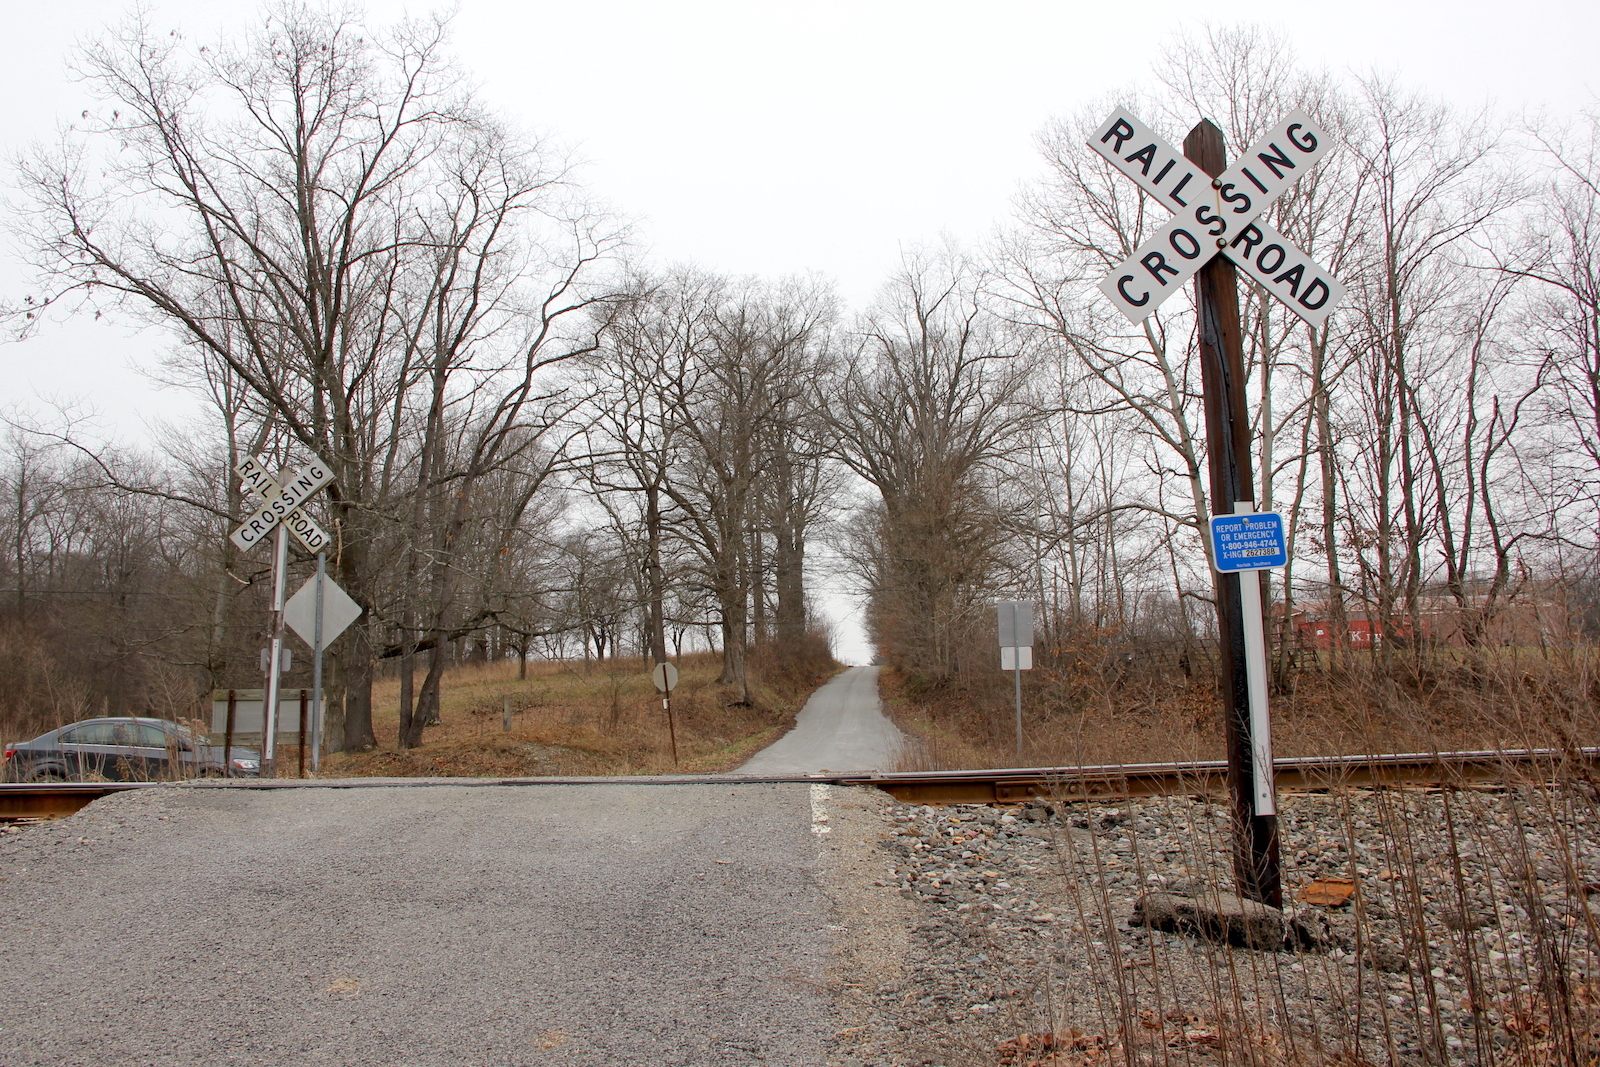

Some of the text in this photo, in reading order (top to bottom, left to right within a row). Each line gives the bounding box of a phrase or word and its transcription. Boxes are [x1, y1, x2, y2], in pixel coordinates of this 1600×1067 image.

[1100, 117, 1330, 311] RAIL ROAD
[1117, 123, 1318, 307] CROSSING
[239, 460, 323, 548] RAIL ROAD
[240, 466, 323, 542] CROSSING
[1216, 521, 1277, 533] REPORT PROBLEM
[1222, 539, 1278, 550] 1-800-946-4744
[1234, 530, 1274, 540] EMERGENCY
[1223, 550, 1242, 559] X-ING
